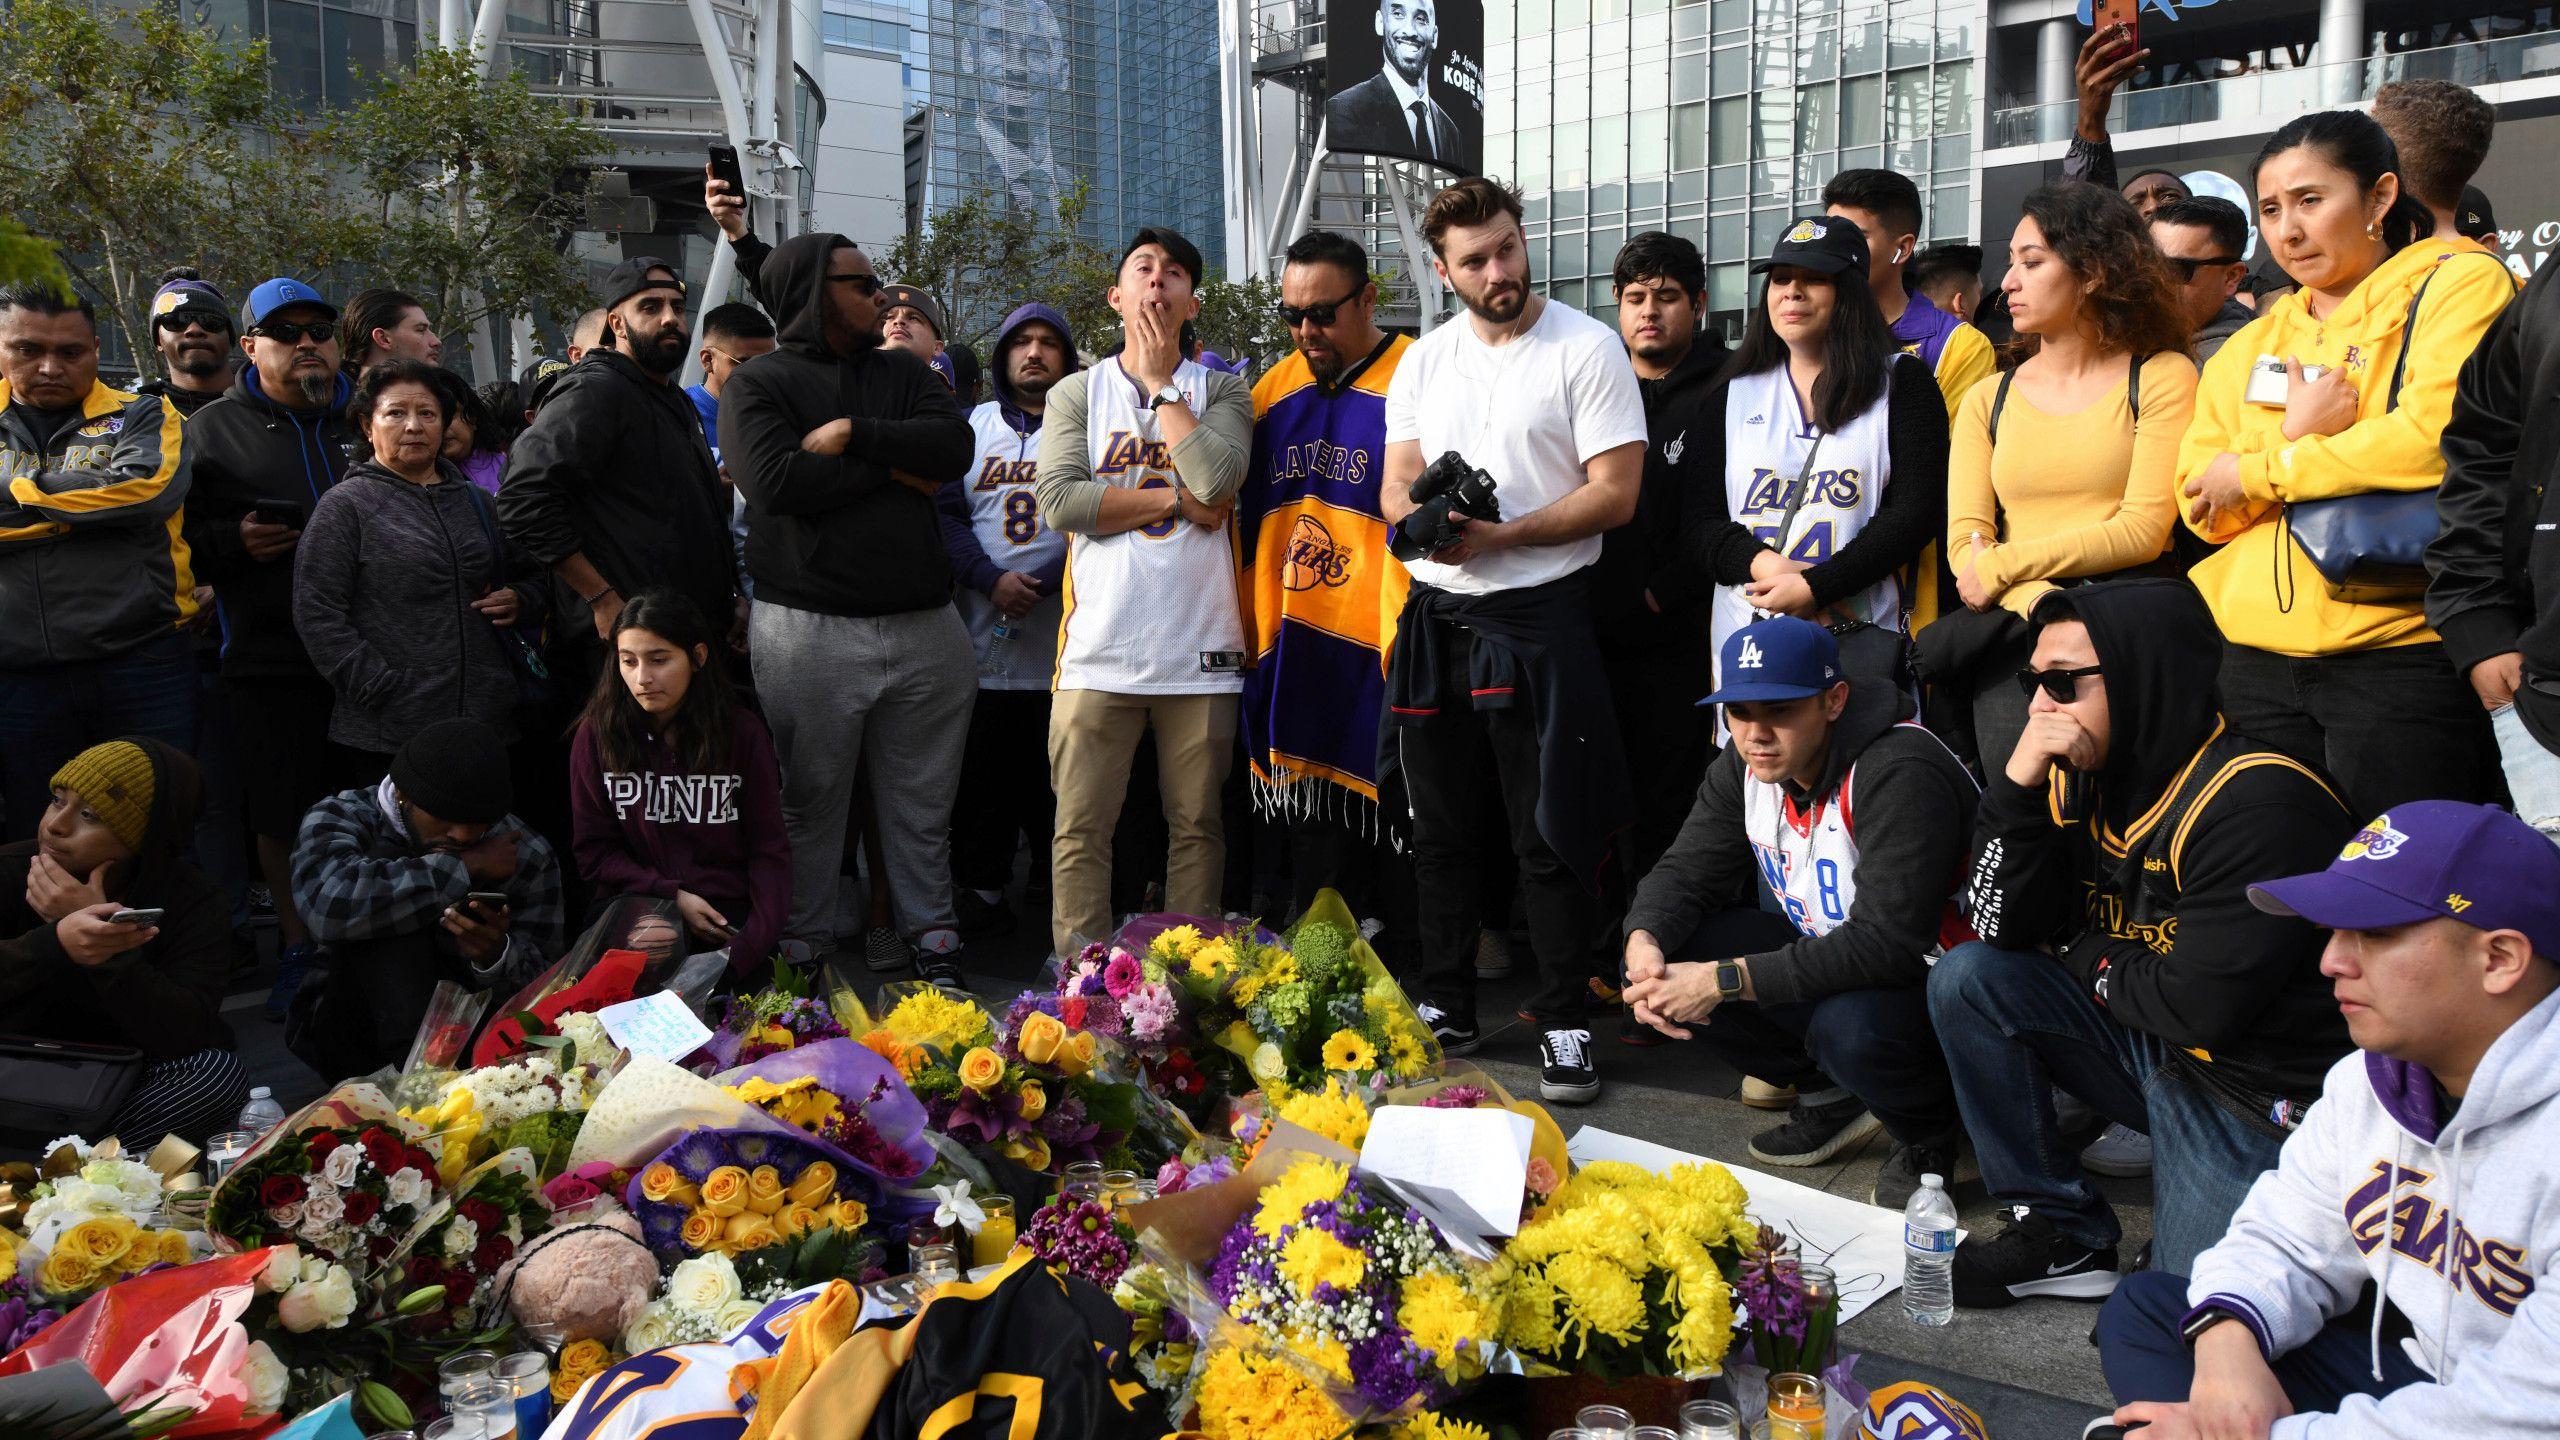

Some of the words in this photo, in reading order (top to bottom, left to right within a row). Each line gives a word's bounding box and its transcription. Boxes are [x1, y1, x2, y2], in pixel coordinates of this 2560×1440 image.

[1443, 64, 1477, 97] KOBE
[1004, 490, 1039, 545] 8
[1738, 635, 1764, 669] LA
[603, 771, 743, 824] PINK
[1816, 858, 1845, 921] 8
[1992, 888, 2003, 914] 2004
